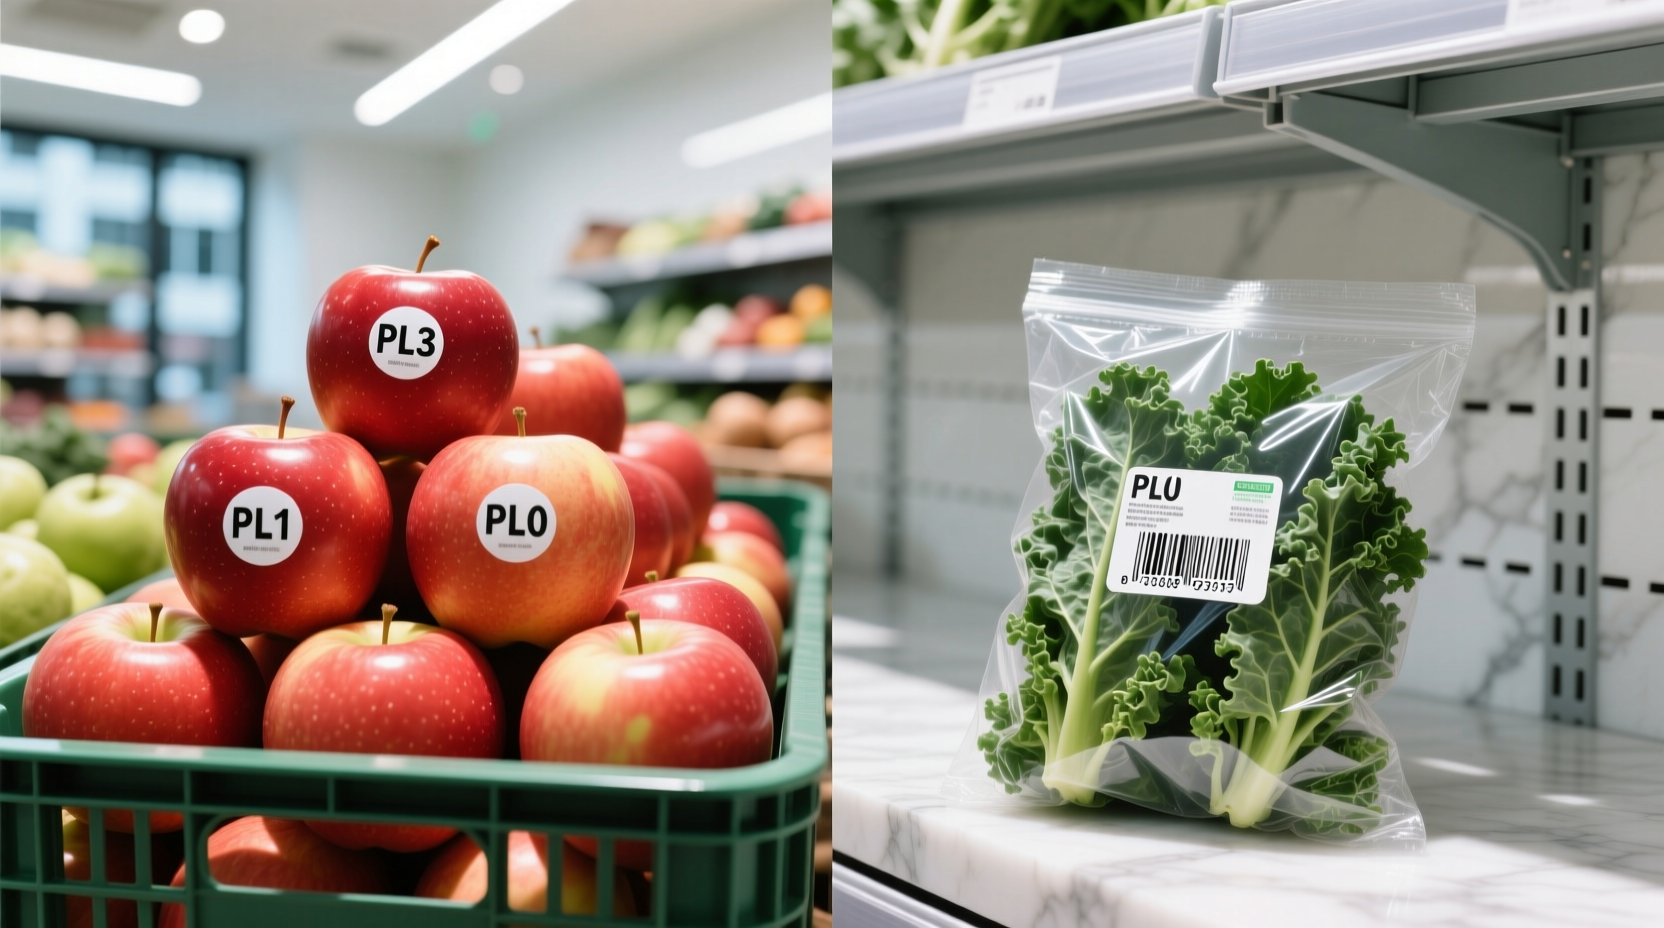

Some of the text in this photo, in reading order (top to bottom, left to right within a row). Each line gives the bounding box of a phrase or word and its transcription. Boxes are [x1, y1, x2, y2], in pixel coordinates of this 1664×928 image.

[377, 323, 436, 357] PL3
[1131, 474, 1182, 502] PLU
[232, 506, 289, 540] PL1
